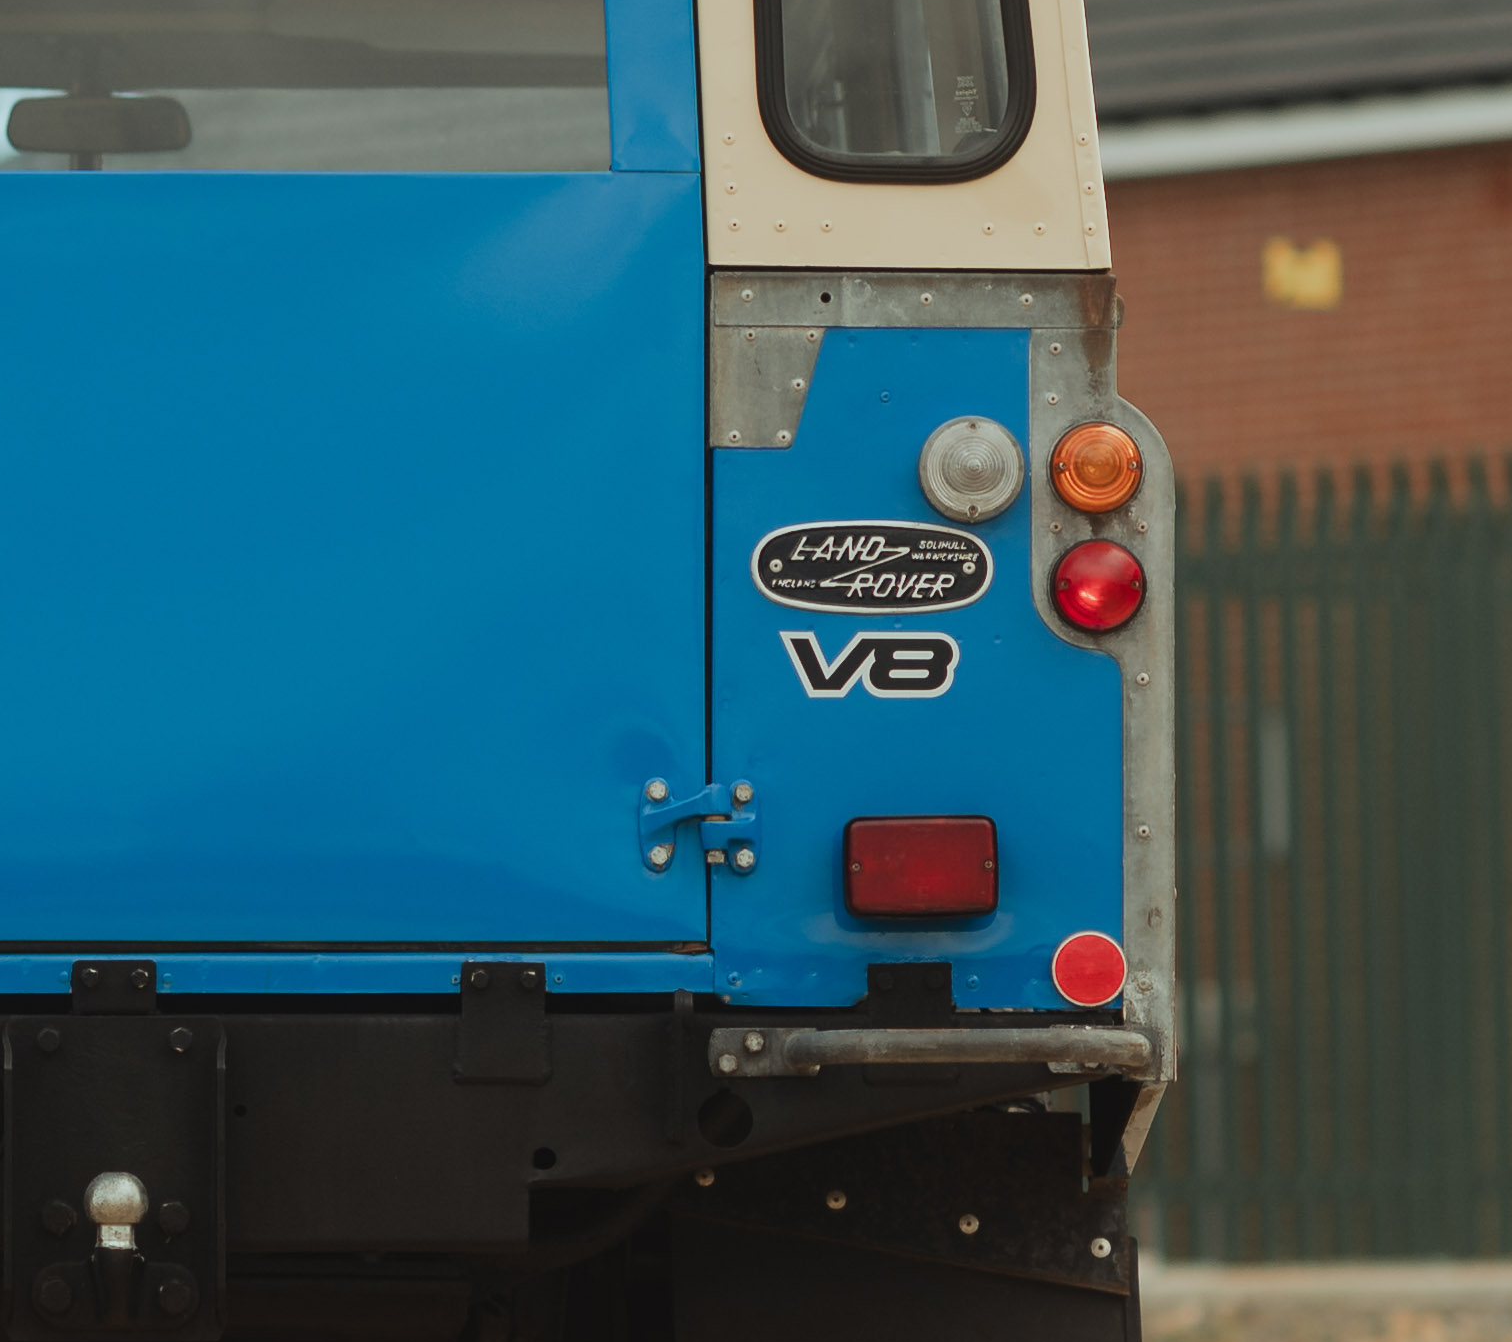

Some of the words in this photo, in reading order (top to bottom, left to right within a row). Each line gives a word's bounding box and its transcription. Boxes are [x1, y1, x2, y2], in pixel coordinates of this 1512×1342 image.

[791, 536, 886, 561] LAND
[919, 540, 967, 550] SOLIHULL
[847, 573, 956, 598] ROVER
[779, 631, 960, 698] V8
